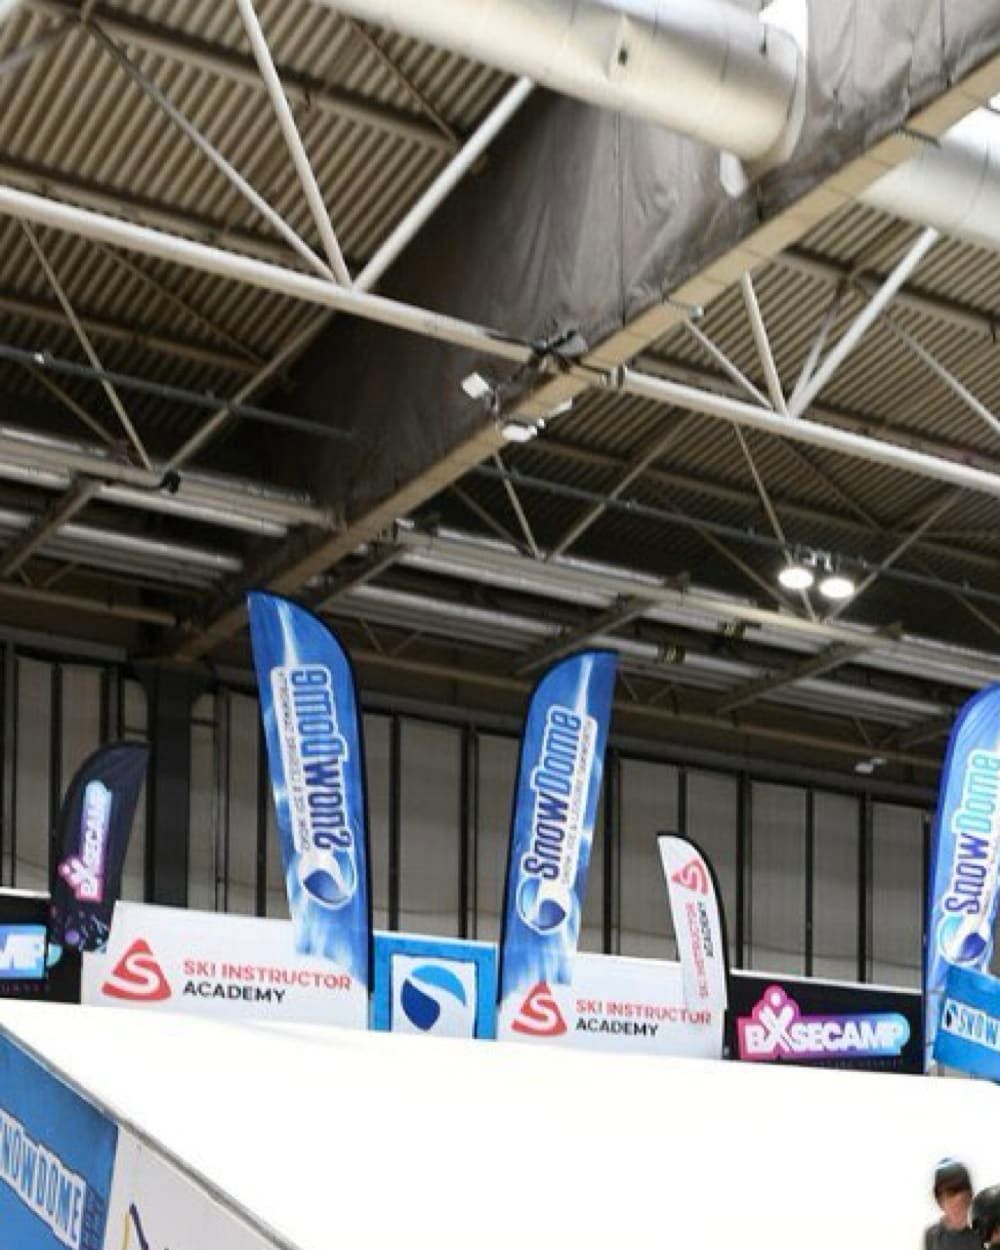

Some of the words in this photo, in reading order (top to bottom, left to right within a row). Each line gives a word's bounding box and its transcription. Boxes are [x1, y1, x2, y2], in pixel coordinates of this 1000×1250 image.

[183, 960, 216, 977] SKI
[221, 963, 353, 991] INSTRUCTOR
[182, 980, 287, 1004] ACADEMY
[575, 999, 603, 1014] SKI
[605, 1001, 713, 1025] INSTRUCTOR
[575, 1017, 660, 1038] ACADEMY
[0, 1115, 82, 1242] NOWDOME
